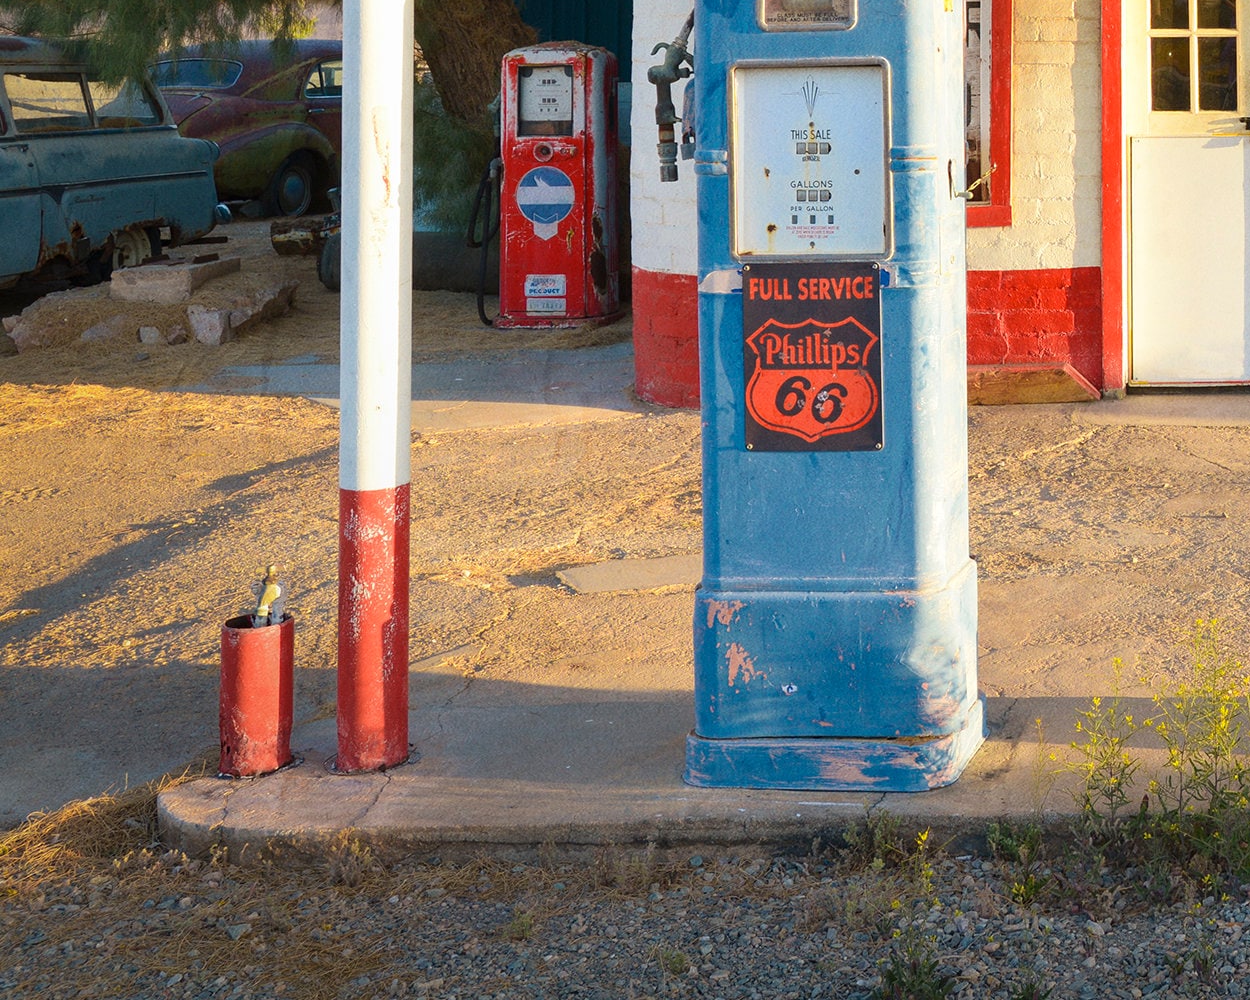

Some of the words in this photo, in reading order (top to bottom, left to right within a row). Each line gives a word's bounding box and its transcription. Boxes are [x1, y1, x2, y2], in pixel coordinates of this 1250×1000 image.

[790, 129, 808, 140] THIS
[809, 129, 832, 140] SALE
[790, 180, 833, 188] GALLONS
[750, 277, 792, 301] FULL
[797, 276, 874, 300] SERVICE
[759, 332, 861, 371] Phillips
[775, 375, 848, 425] 66
